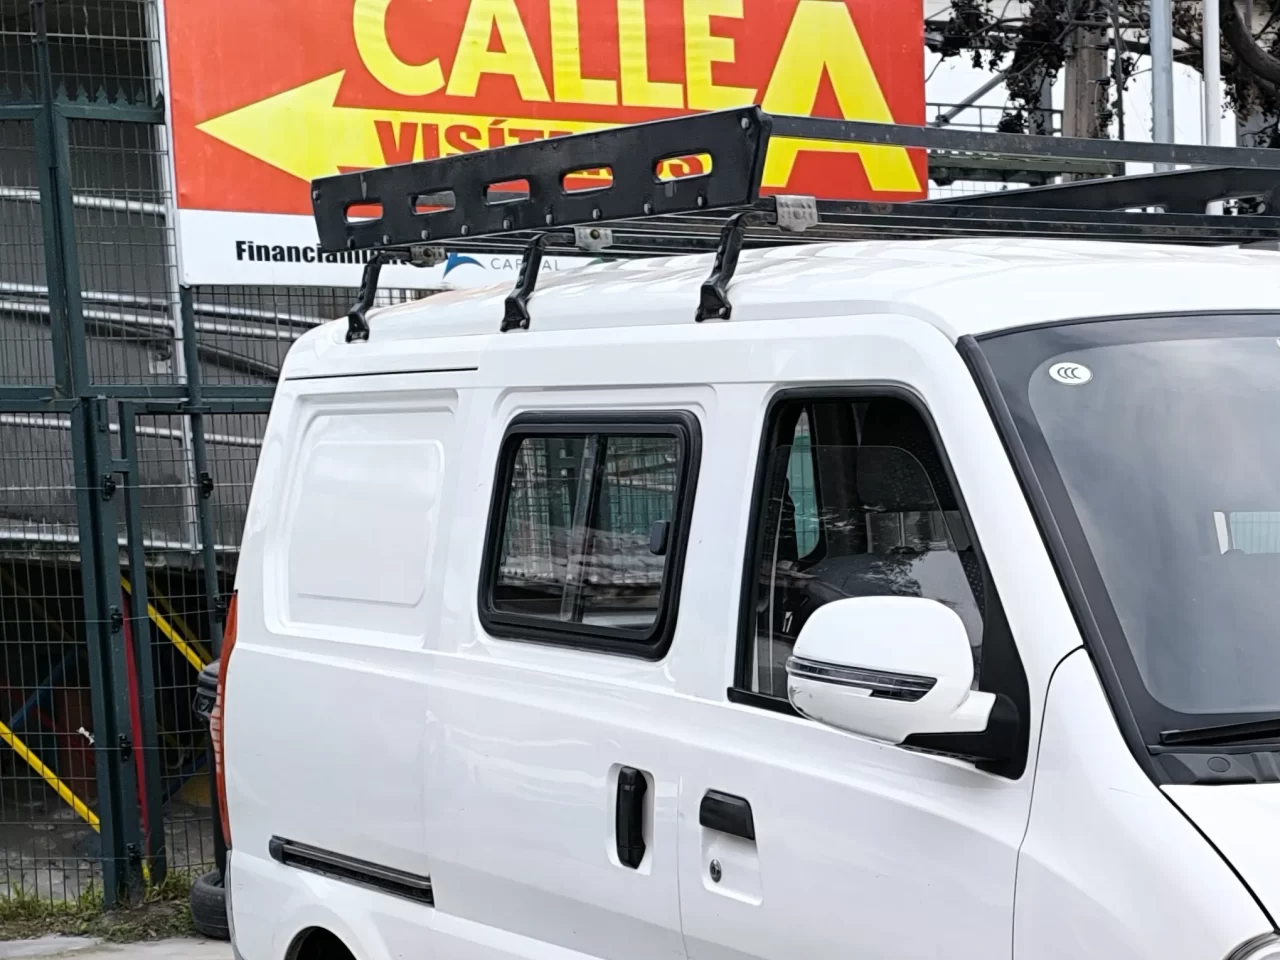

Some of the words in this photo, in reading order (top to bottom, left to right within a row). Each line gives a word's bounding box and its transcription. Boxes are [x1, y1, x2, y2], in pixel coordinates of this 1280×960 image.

[352, 0, 758, 110] CALLE
[760, 1, 923, 193] A
[490, 257, 561, 271] CAPAL
